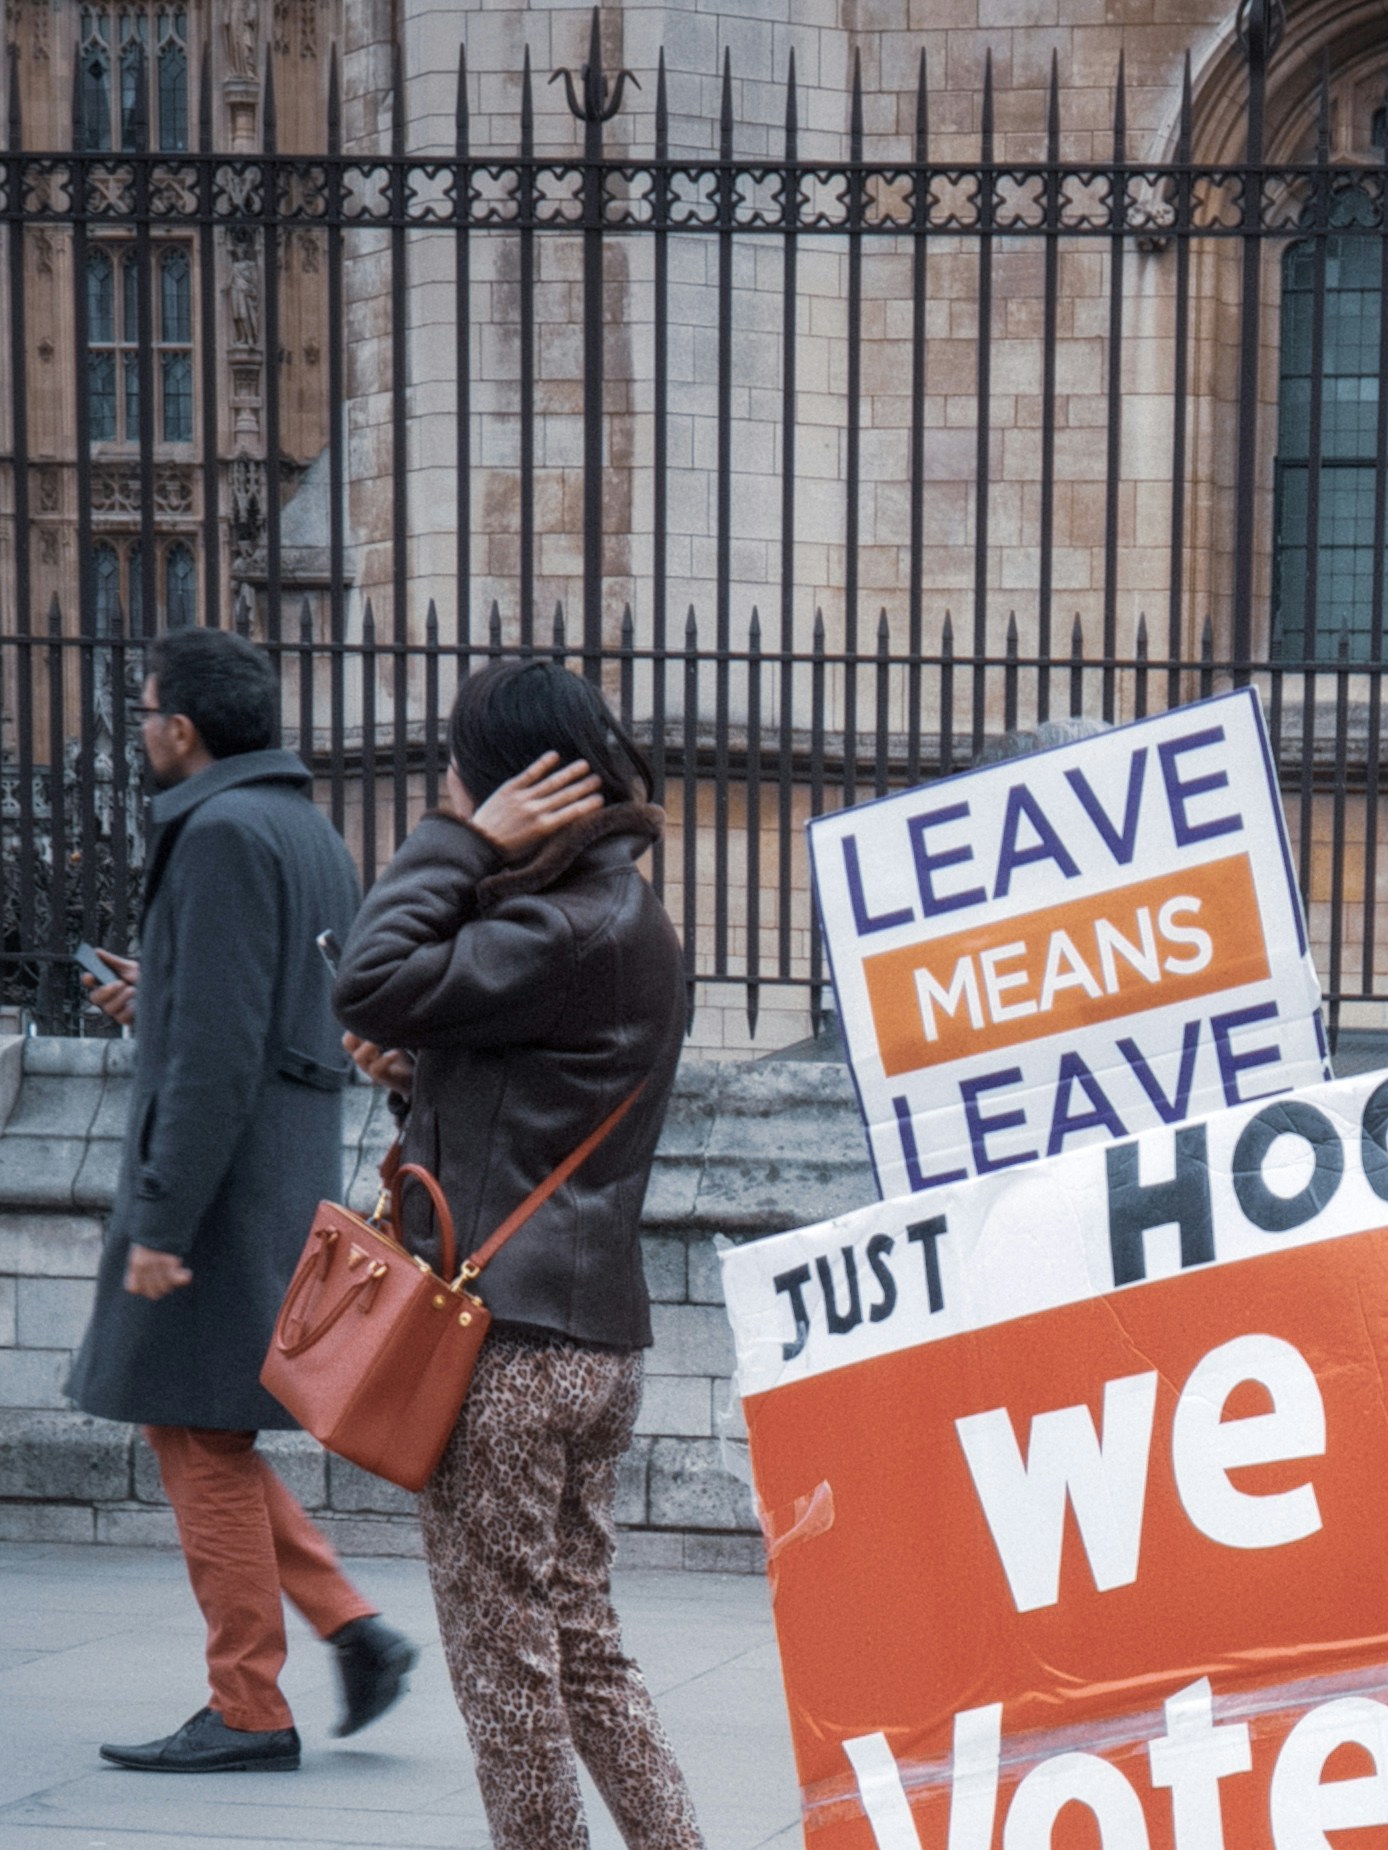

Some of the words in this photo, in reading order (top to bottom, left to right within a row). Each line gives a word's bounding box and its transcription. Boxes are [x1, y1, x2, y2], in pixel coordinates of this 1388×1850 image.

[841, 725, 1244, 937] LEAVE
[913, 895, 1213, 1043] MEANS
[892, 1001, 1292, 1193] LEAVE
[773, 1214, 948, 1361] JUST
[954, 1333, 1326, 1612] we
